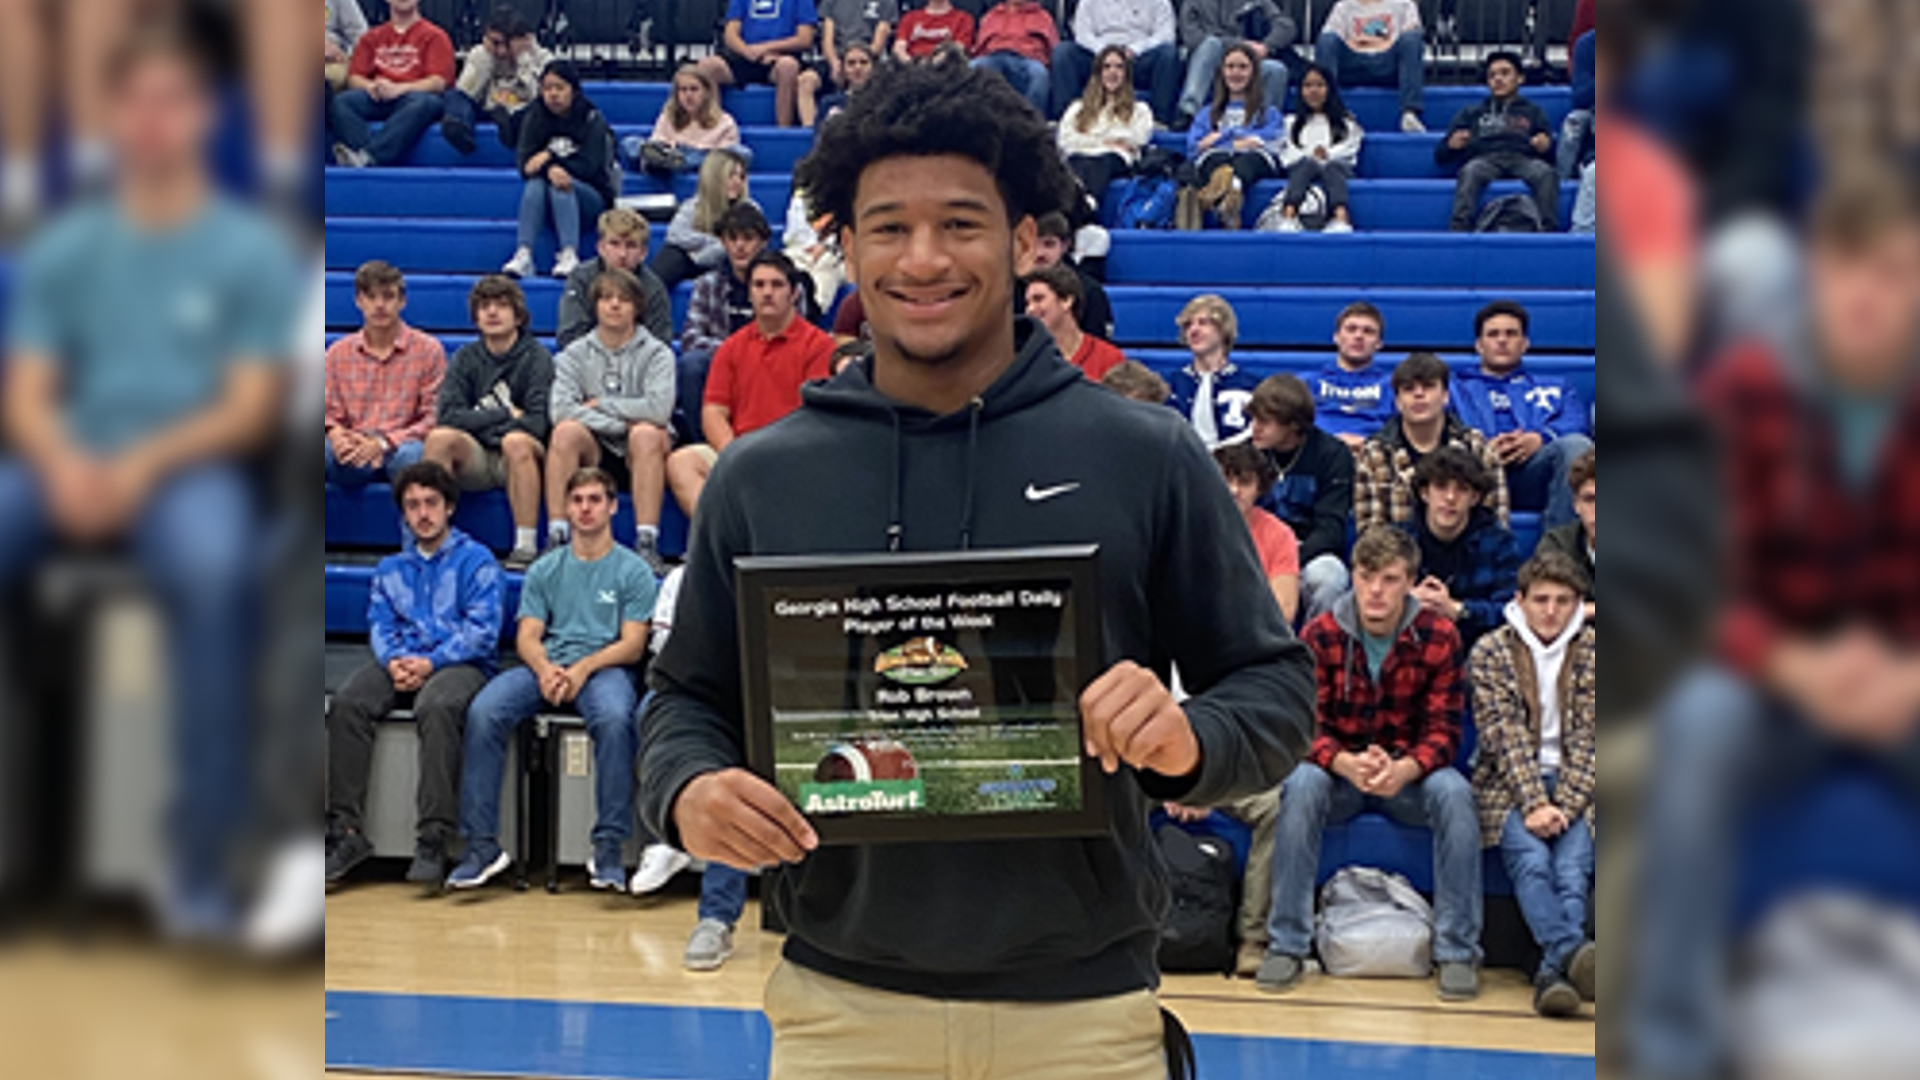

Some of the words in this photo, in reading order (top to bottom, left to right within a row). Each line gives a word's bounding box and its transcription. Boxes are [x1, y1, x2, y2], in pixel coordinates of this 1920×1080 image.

[775, 600, 838, 618] Georgia
[844, 598, 881, 615] High
[886, 594, 941, 611] School
[948, 591, 1014, 609] Football
[1019, 589, 1061, 607] Daily
[844, 618, 895, 634] Player
[899, 616, 917, 630] of
[921, 616, 945, 630] the
[949, 613, 994, 628] Week
[877, 689, 910, 703] Rob
[914, 687, 971, 702] Brown
[937, 706, 980, 719] School
[804, 790, 919, 814] AstroTurf
